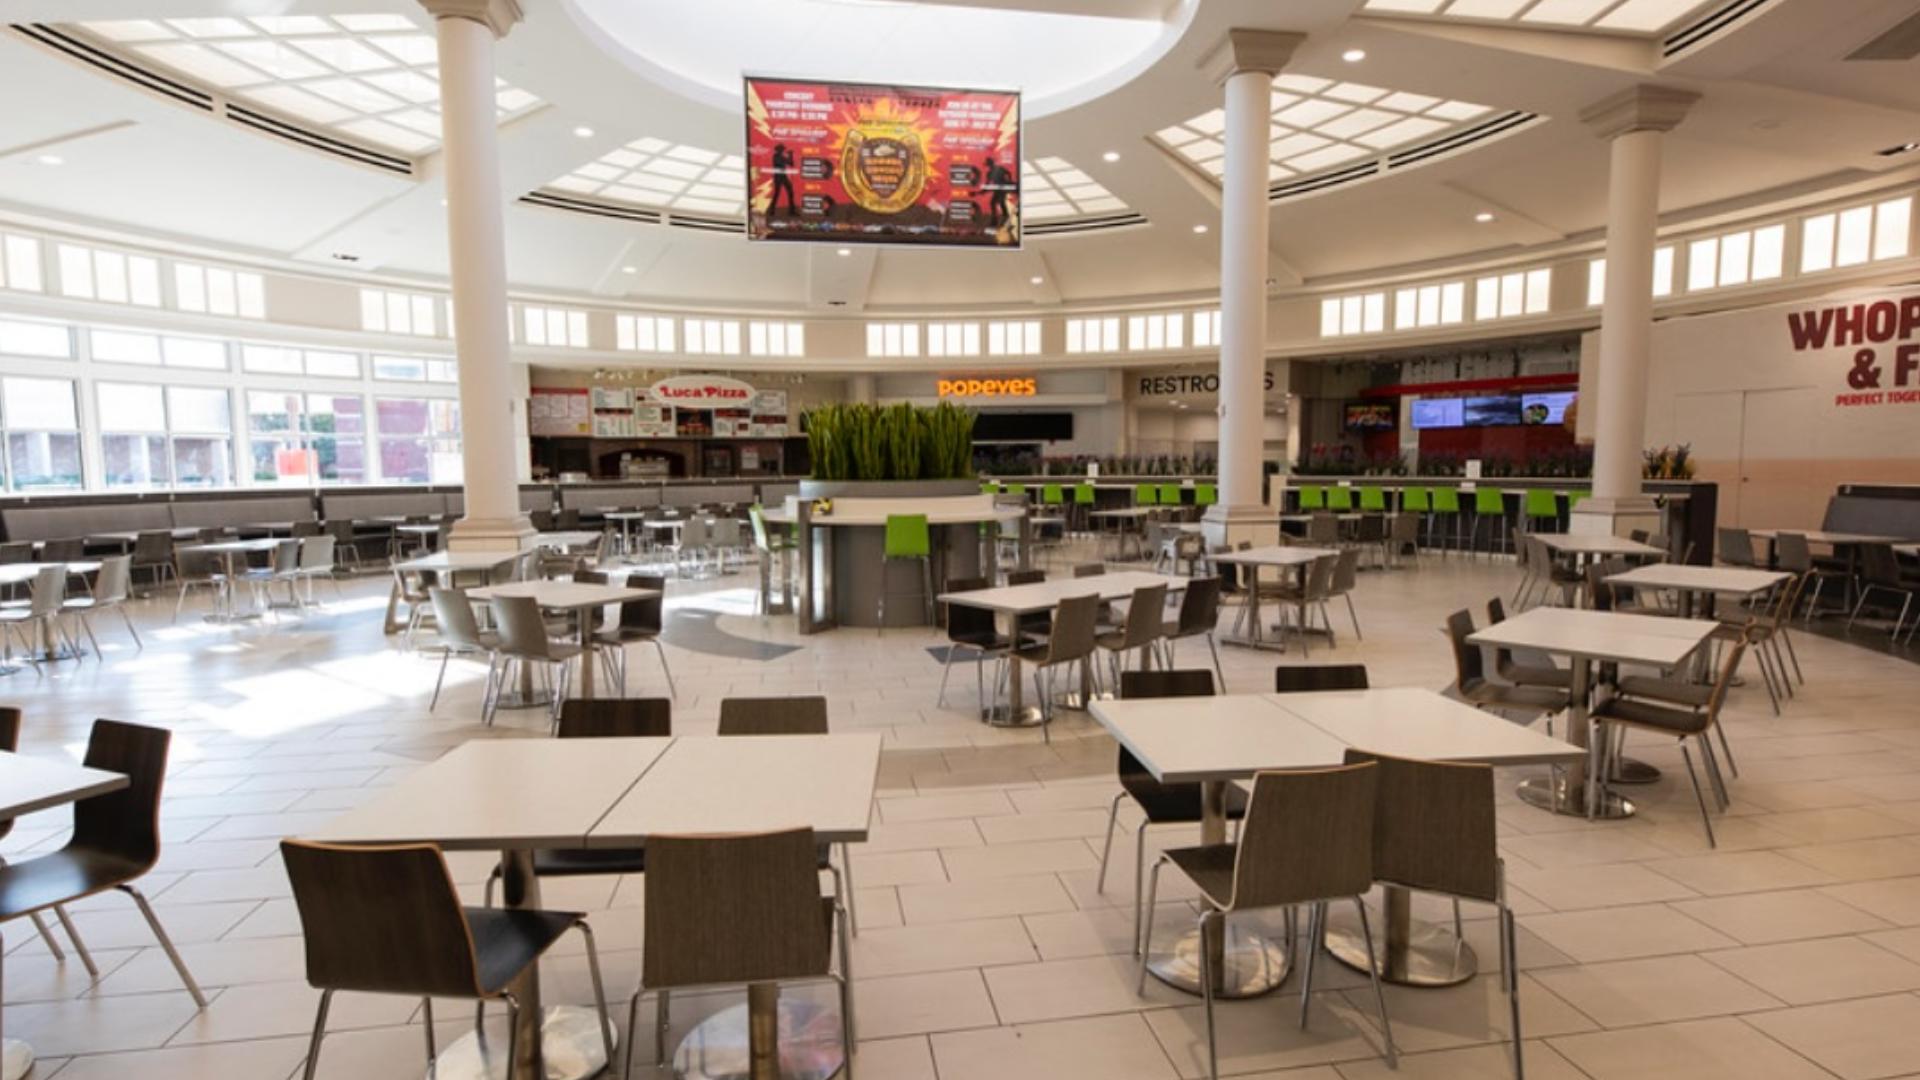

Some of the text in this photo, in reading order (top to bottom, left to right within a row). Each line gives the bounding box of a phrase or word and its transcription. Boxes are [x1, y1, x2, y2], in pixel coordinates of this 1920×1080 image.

[1788, 297, 1920, 350] WHOP
[1140, 371, 1274, 395] RESTROS
[1847, 348, 1882, 390] &
[1835, 393, 1884, 406] PERFECT
